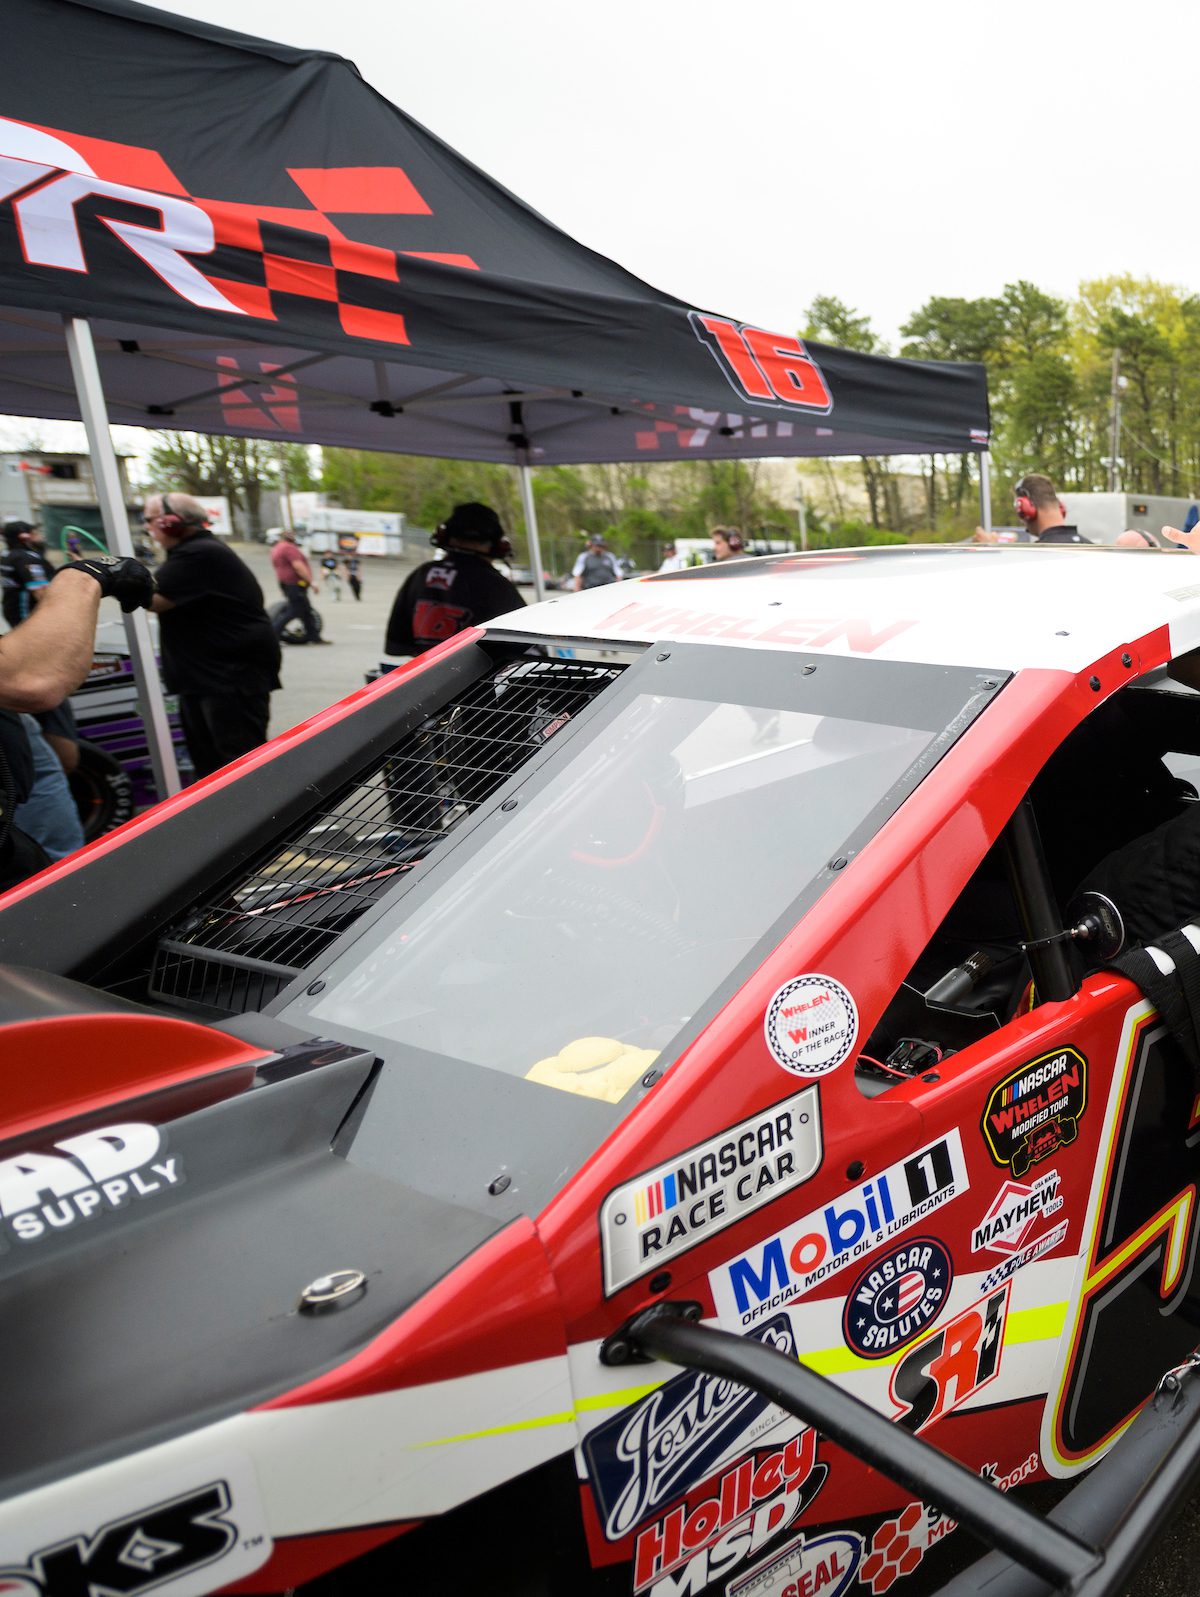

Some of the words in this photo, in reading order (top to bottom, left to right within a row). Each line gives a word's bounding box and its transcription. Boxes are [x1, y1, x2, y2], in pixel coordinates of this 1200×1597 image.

[695, 312, 832, 411] 16
[591, 602, 921, 655] WHELEN
[780, 991, 831, 1019] WHELEN
[788, 1021, 836, 1045] WINNER
[791, 1048, 803, 1060] OF
[805, 1039, 822, 1054] THE
[823, 1029, 846, 1046] RACE
[1018, 1054, 1068, 1098] NASCAR
[990, 1064, 1080, 1135] WHELEN
[1011, 1108, 1049, 1140] MODIFIED
[1050, 1095, 1069, 1117] TOUR
[0, 1122, 161, 1218] AD
[676, 1111, 795, 1203] NASCAR
[11, 1158, 179, 1240] SUPPLY
[641, 1188, 726, 1259] RACE
[735, 1150, 797, 1202] CAR
[974, 1181, 1057, 1250] MAYHEW
[1045, 1197, 1063, 1216] TOOLS
[727, 1174, 895, 1315] Mobil
[741, 1284, 801, 1326] OFFICIAL
[804, 1252, 850, 1288] MOTOR
[853, 1240, 872, 1257] OIL
[875, 1230, 884, 1244] &
[887, 1184, 956, 1237] LUBRICANTS
[856, 1246, 933, 1306] NASCAR
[1010, 1248, 1032, 1271] POLE
[861, 1286, 943, 1349] SALUTES
[750, 1416, 778, 1438] SINCE
[634, 1428, 817, 1592] Holley
